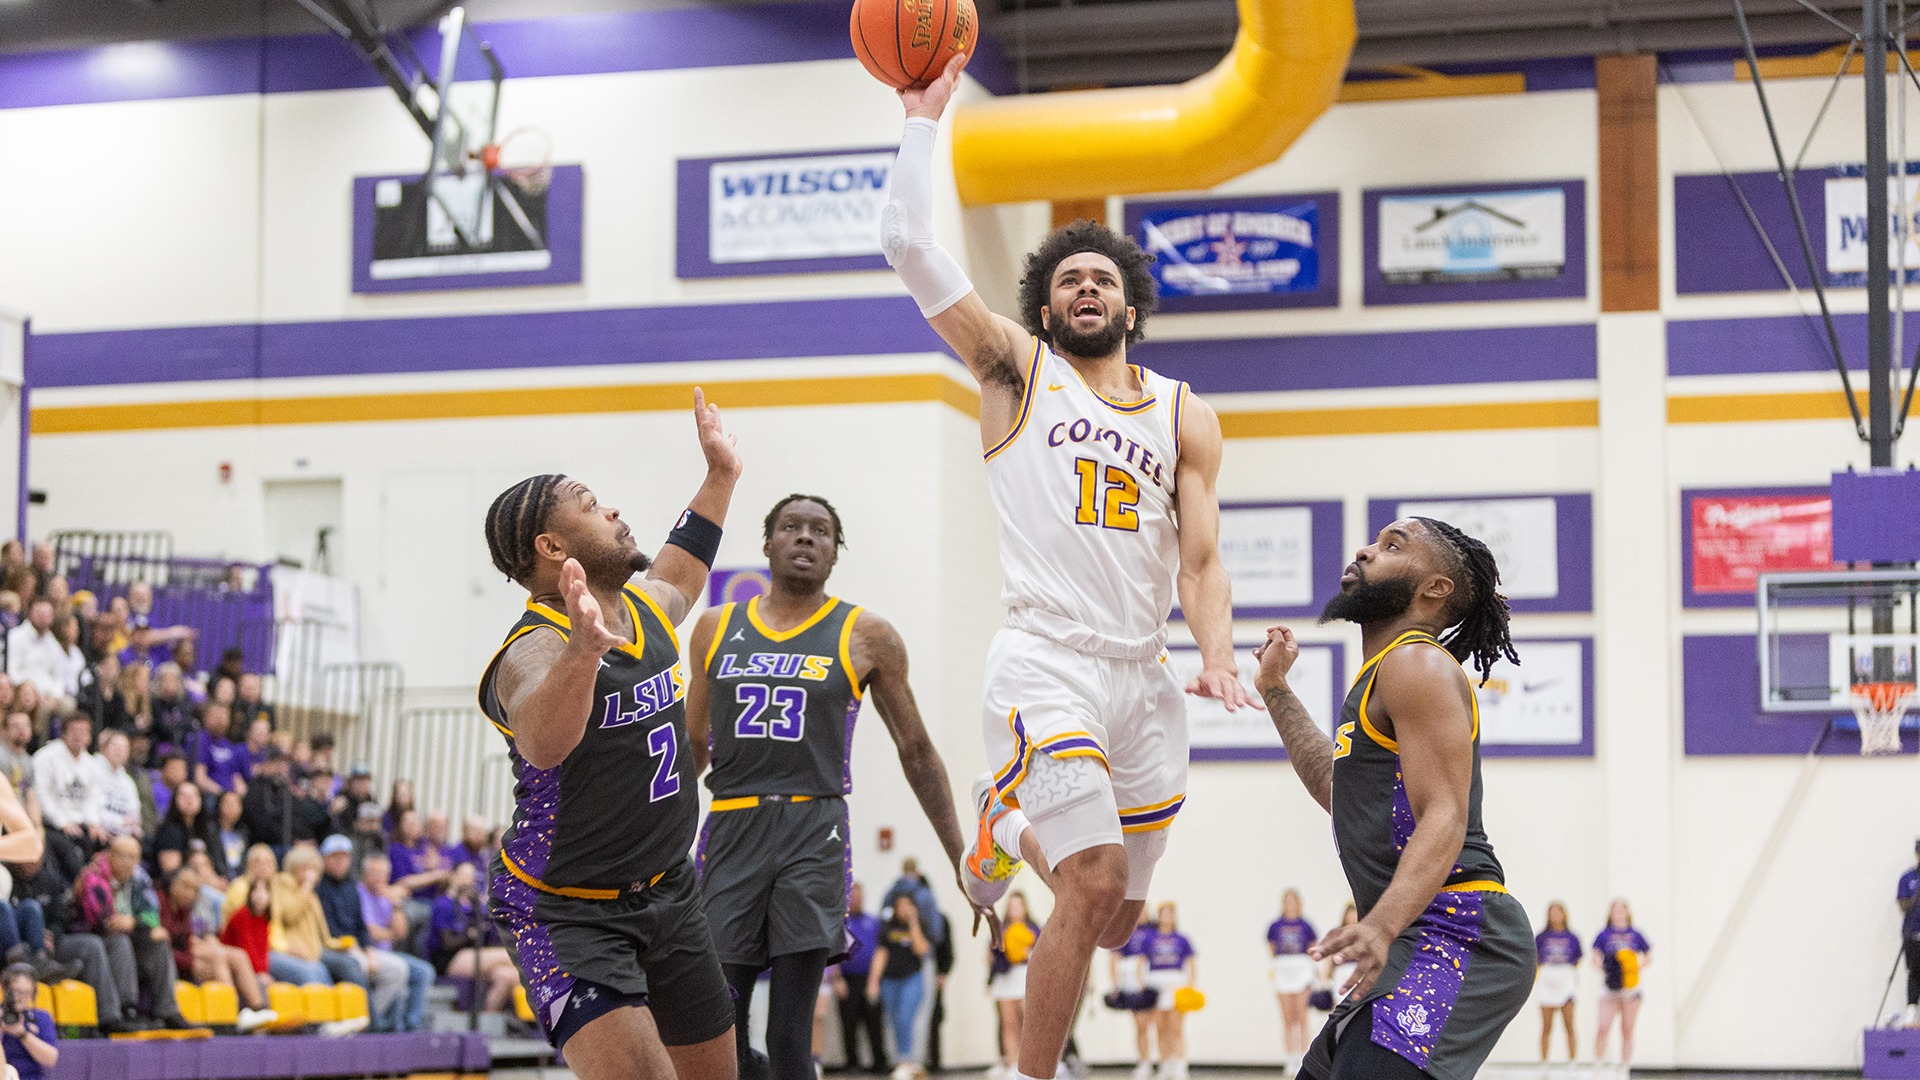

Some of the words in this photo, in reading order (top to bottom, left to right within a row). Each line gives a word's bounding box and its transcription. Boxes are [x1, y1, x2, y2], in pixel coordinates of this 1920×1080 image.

[947, 0, 967, 52] LEGA
[722, 168, 888, 198] WILSON
[1074, 457, 1140, 532] 12
[599, 660, 685, 729] LSUS
[716, 653, 833, 681] LSUS
[735, 683, 807, 742] 23
[647, 721, 680, 803] 2
